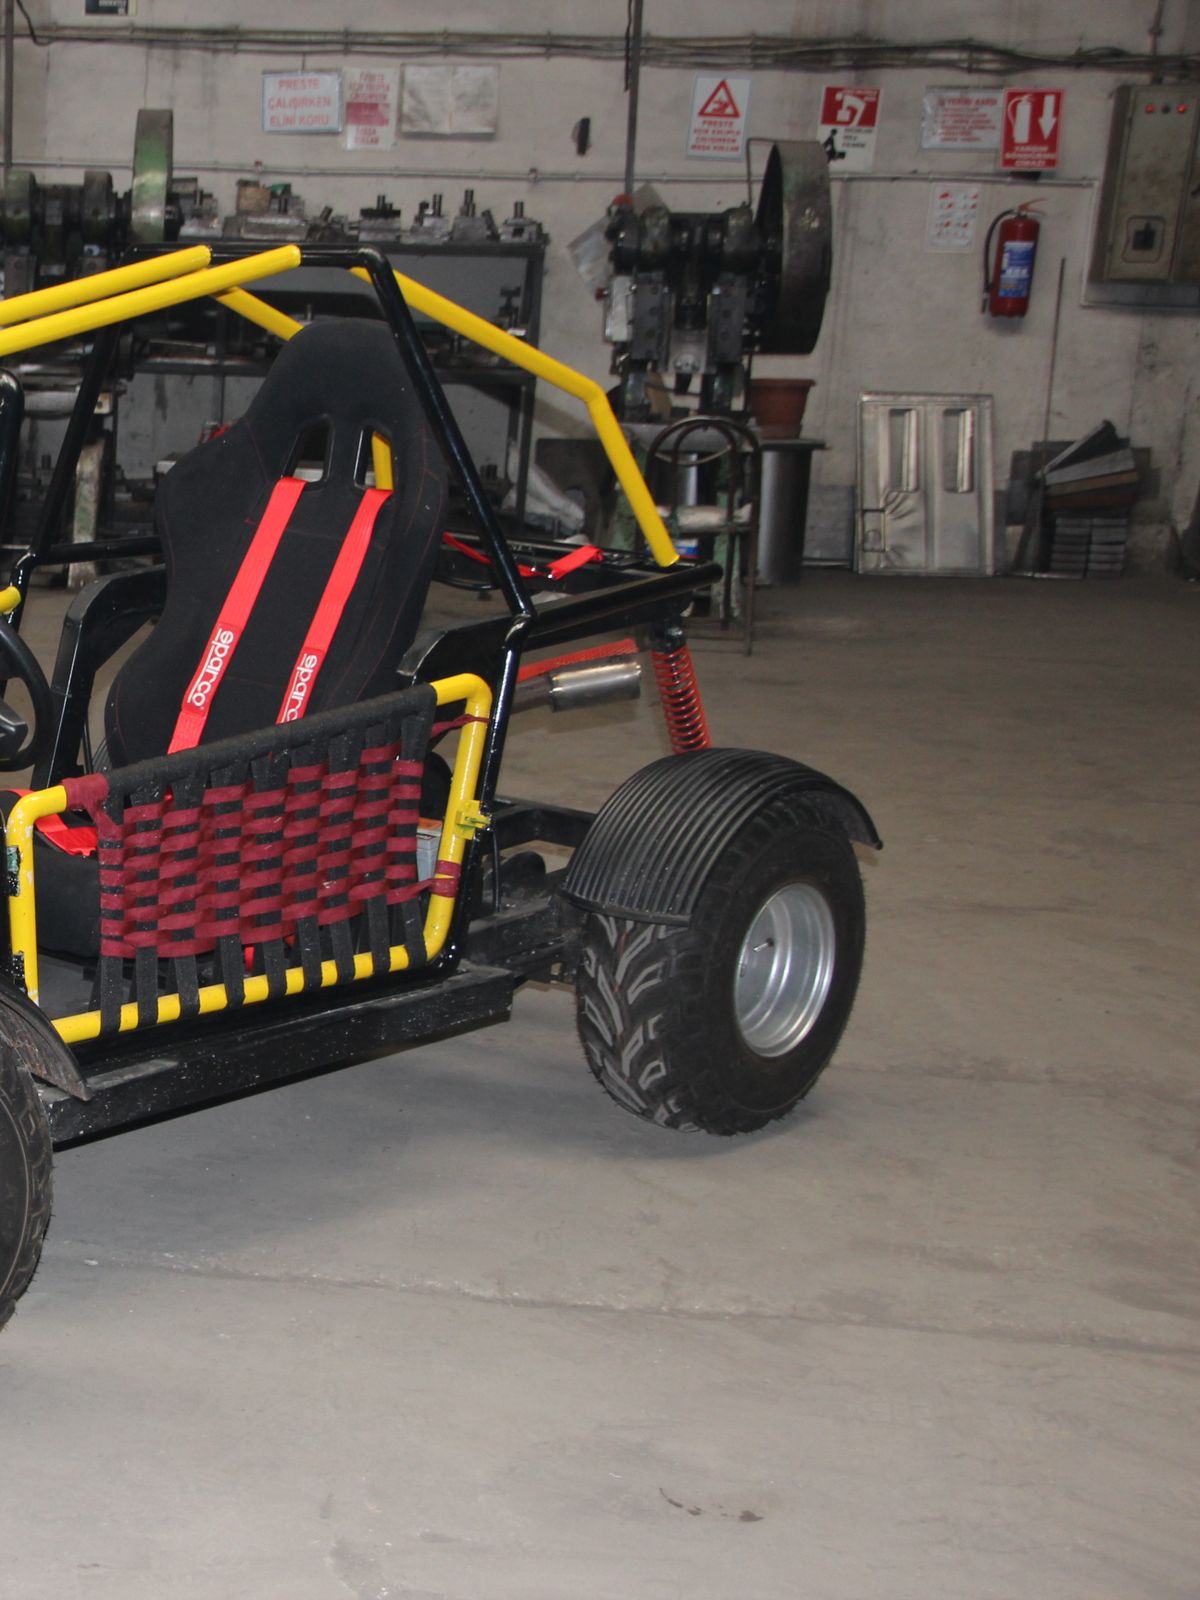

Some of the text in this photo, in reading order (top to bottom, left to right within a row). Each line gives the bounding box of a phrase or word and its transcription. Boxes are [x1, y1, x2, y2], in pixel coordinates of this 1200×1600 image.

[278, 79, 320, 91] PRESTE
[187, 628, 235, 707] sparco
[281, 653, 318, 723] sparc
